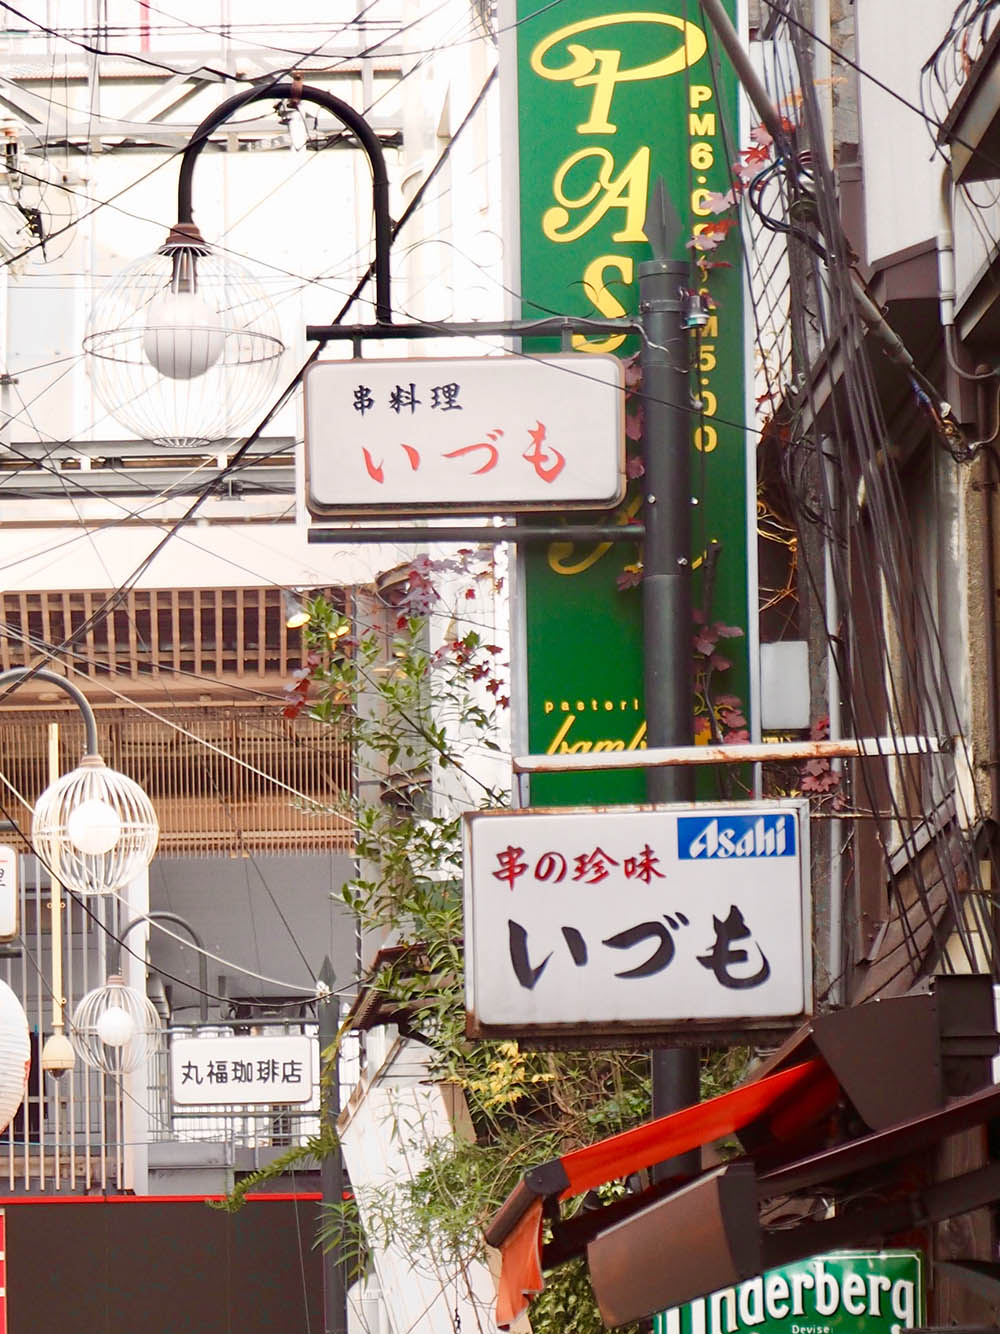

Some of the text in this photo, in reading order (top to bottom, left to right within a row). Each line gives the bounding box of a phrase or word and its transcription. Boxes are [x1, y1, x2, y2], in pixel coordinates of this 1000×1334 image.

[352, 383, 464, 413] 串料理
[362, 420, 567, 485] いづも
[688, 817, 787, 859] Asahi
[490, 845, 666, 891] 串の珍味
[507, 903, 771, 991] いづも
[181, 1059, 303, 1085] 丸福珈琲店
